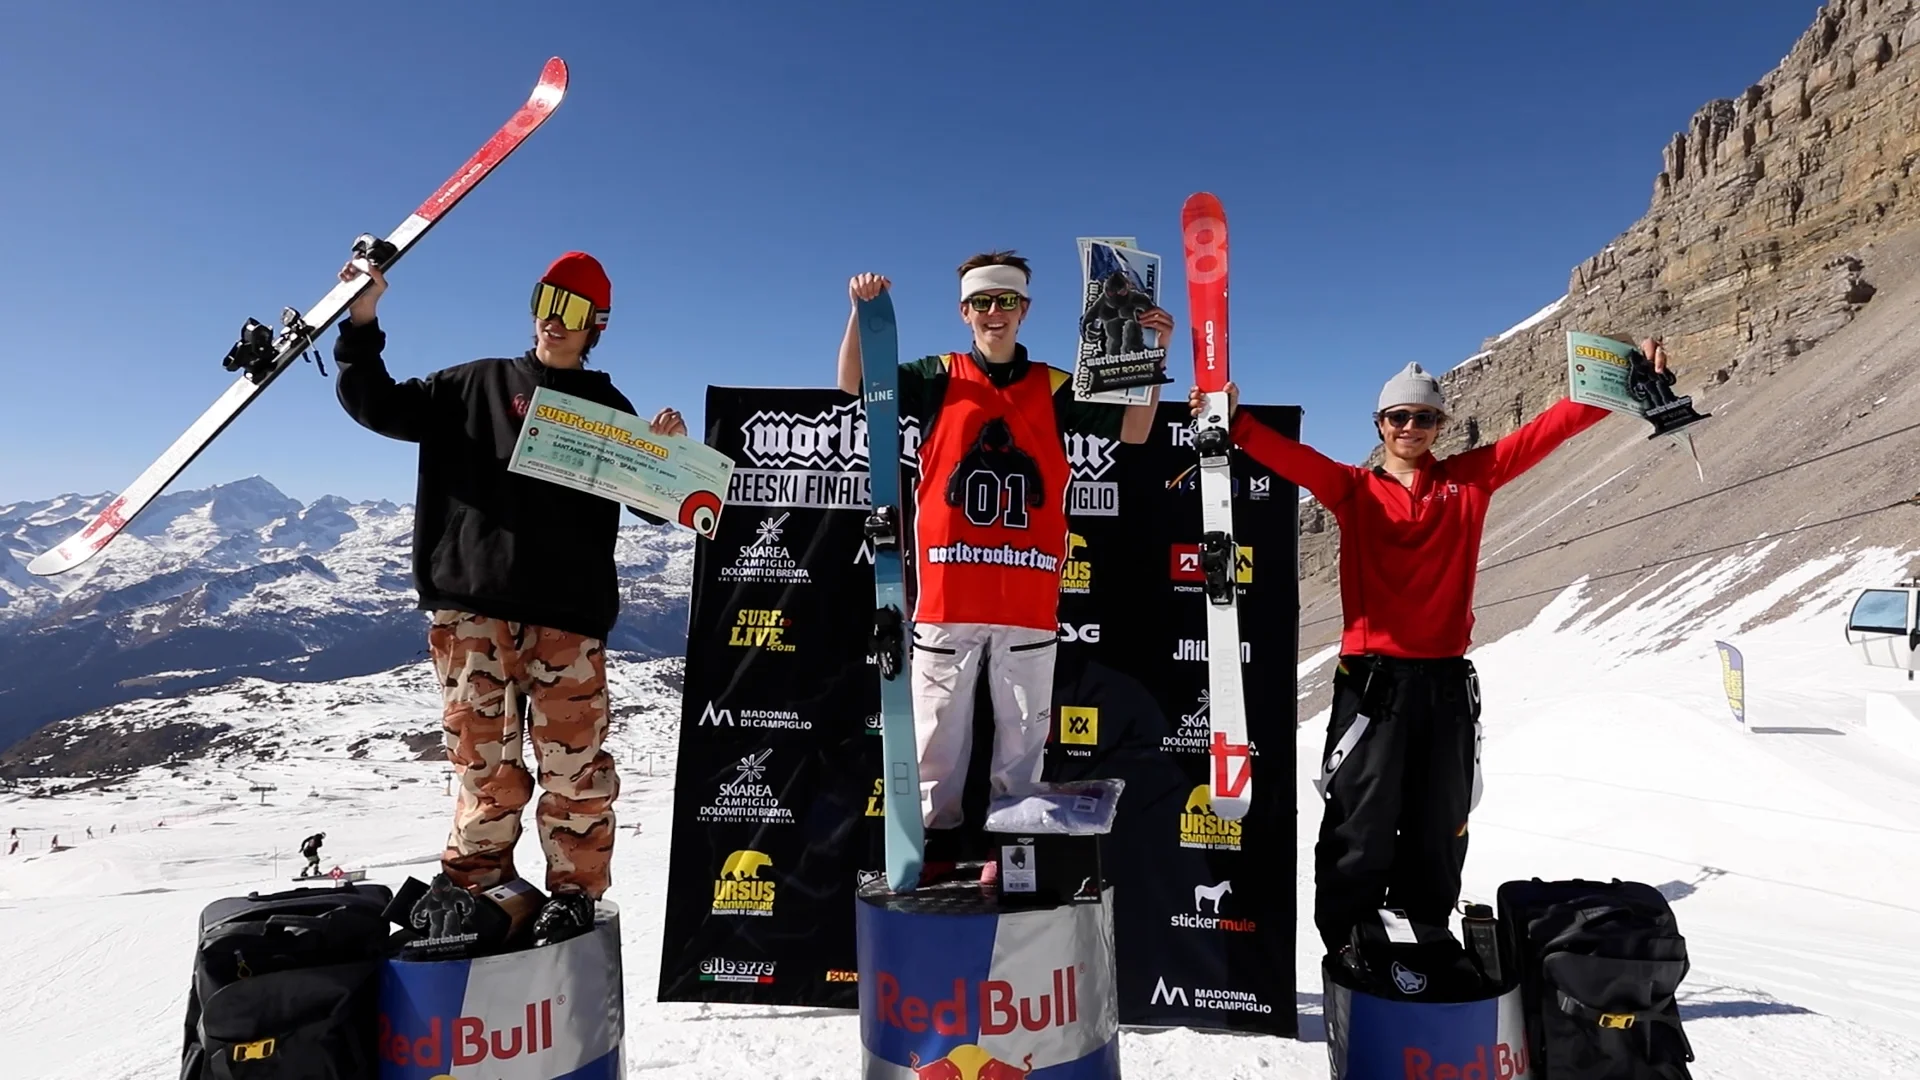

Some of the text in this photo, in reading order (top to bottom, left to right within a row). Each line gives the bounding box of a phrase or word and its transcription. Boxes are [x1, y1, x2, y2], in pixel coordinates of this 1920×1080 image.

[438, 163, 483, 203] HEAD
[1205, 320, 1216, 370] HEAD
[1099, 363, 1155, 377] BEST ROOKIE
[868, 389, 894, 403] LINE
[534, 404, 670, 460] SURFtoLIVE.com
[552, 441, 592, 458] SANTANDER
[728, 473, 797, 503] REESKI
[965, 470, 1028, 529] 01
[1073, 486, 1115, 510] IGLIO
[735, 558, 796, 568] CAMPIGLIO
[928, 541, 1058, 573] worldrookietour
[721, 567, 809, 578] DOLOMITI DI BRENTA
[737, 609, 783, 627] SURF
[728, 627, 785, 647] LIVE
[1060, 622, 1101, 643] SG
[766, 643, 796, 652] .com
[740, 709, 799, 720] MADONNA
[740, 719, 812, 730] DI CAMPIGLIO
[1163, 736, 1209, 747] DOLOMITI
[715, 797, 779, 807] CAMPIGLIO
[700, 806, 793, 818] DOLOMITI DI BRENTA
[1180, 812, 1242, 836] URSUS
[1180, 833, 1242, 846] SNOWPARK
[714, 879, 776, 902] URSUS
[712, 900, 774, 911] SNOWPARK
[1170, 913, 1256, 933] stickermule
[700, 956, 775, 976] elleerre
[875, 965, 1078, 1037] Red Bull
[1194, 988, 1257, 1002] MADONNA
[1194, 999, 1272, 1014] DI CAMPIGLIO
[452, 998, 553, 1067] Bull
